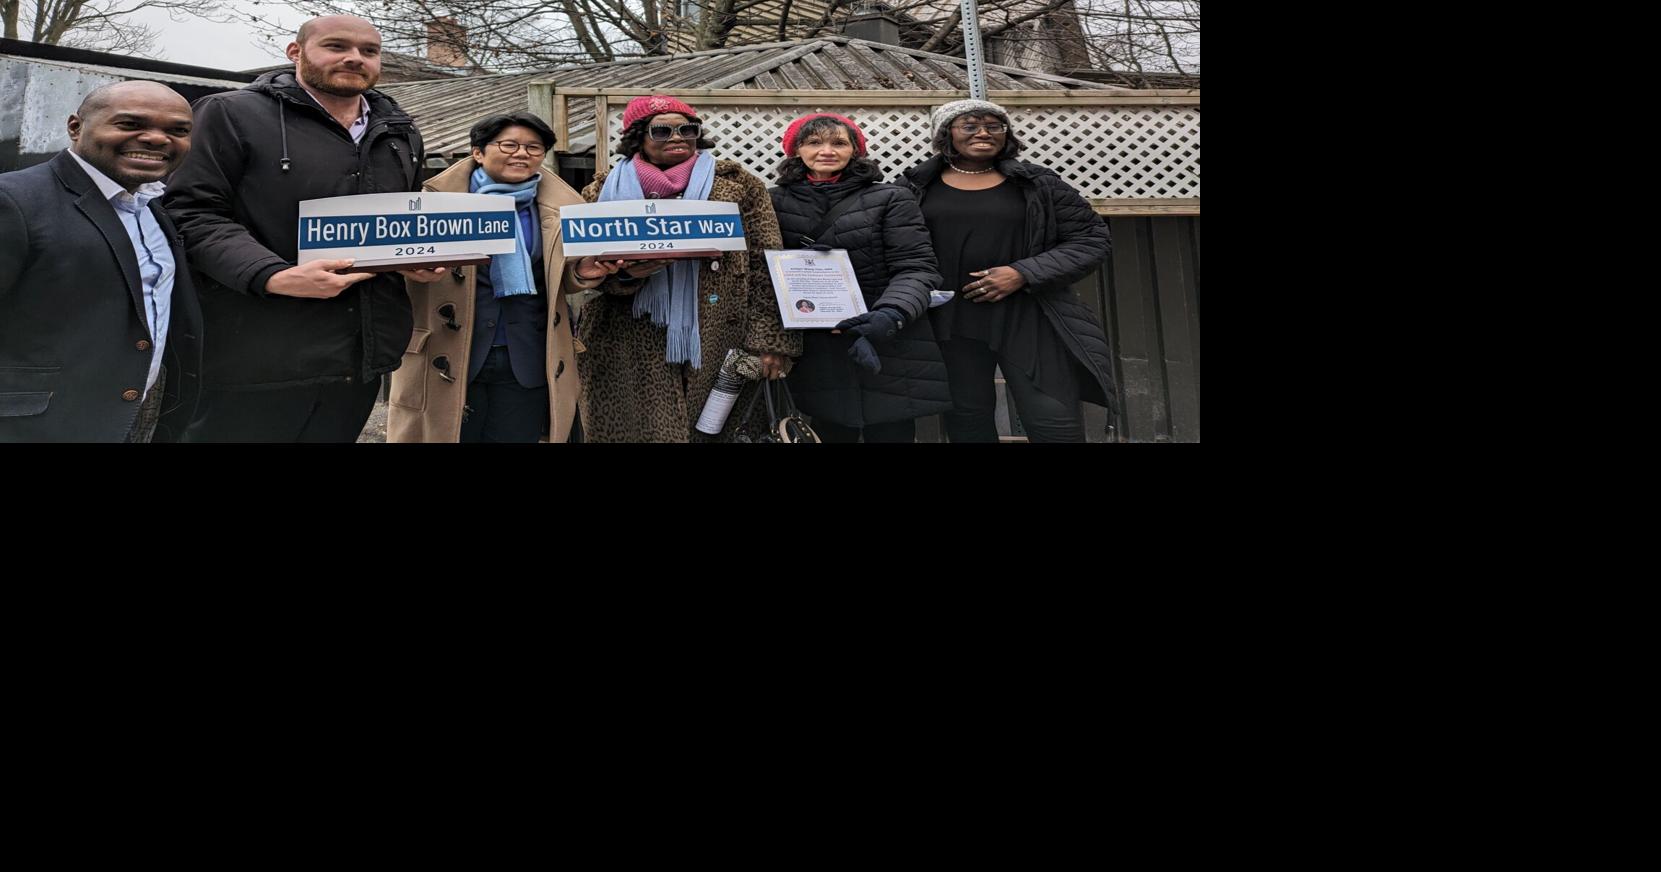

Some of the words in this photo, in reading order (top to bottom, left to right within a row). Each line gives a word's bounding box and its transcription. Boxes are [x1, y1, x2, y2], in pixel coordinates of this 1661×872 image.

[307, 218, 369, 246] Henry
[375, 216, 411, 239] Box
[416, 215, 473, 237] Brown
[478, 217, 510, 235] Lane
[568, 218, 639, 239] North
[646, 217, 692, 236] Star
[698, 219, 735, 237] Way
[394, 245, 436, 256] 2024
[639, 241, 674, 250] 2024
